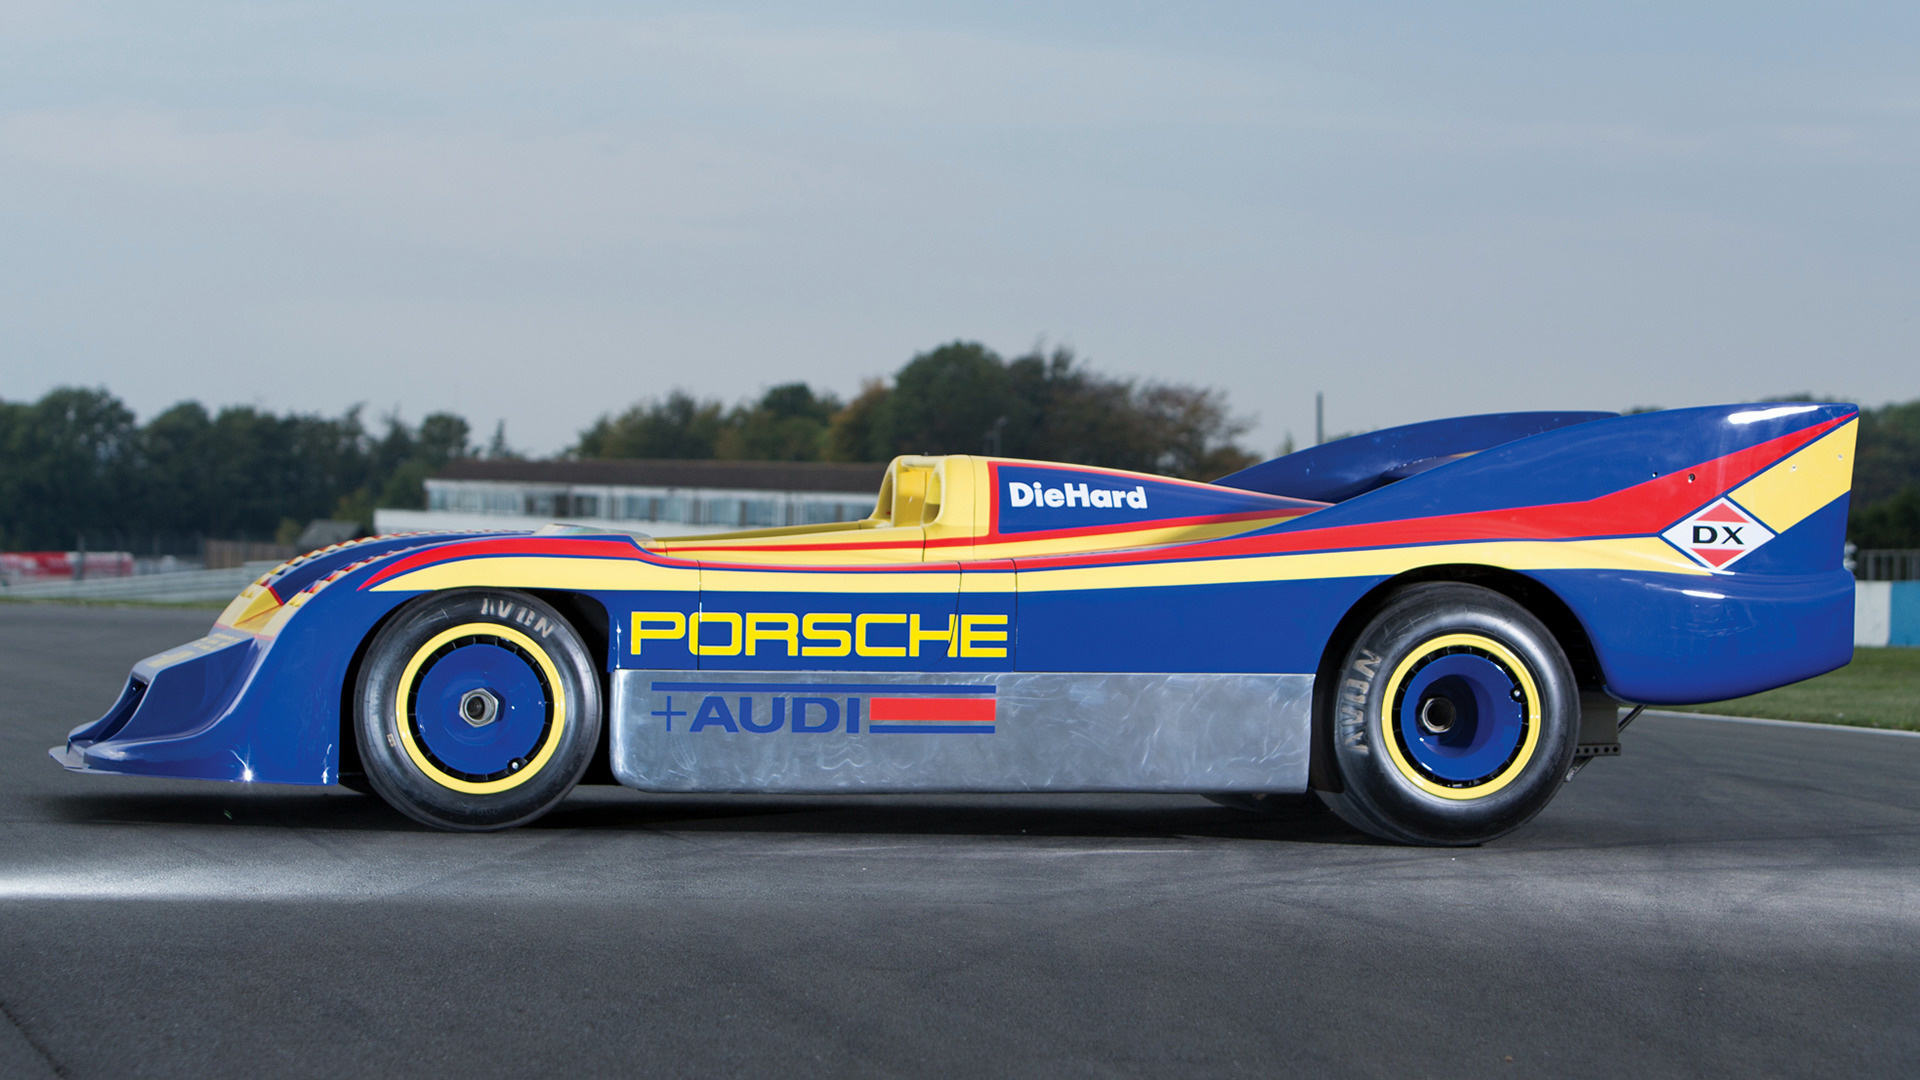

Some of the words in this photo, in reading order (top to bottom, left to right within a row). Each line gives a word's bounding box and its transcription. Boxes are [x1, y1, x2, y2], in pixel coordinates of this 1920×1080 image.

[1009, 481, 1148, 509] DieHard
[1692, 525, 1745, 545] DX
[480, 598, 554, 639] AVON
[630, 611, 1009, 657] PORSCHE
[1341, 648, 1382, 755] AVON
